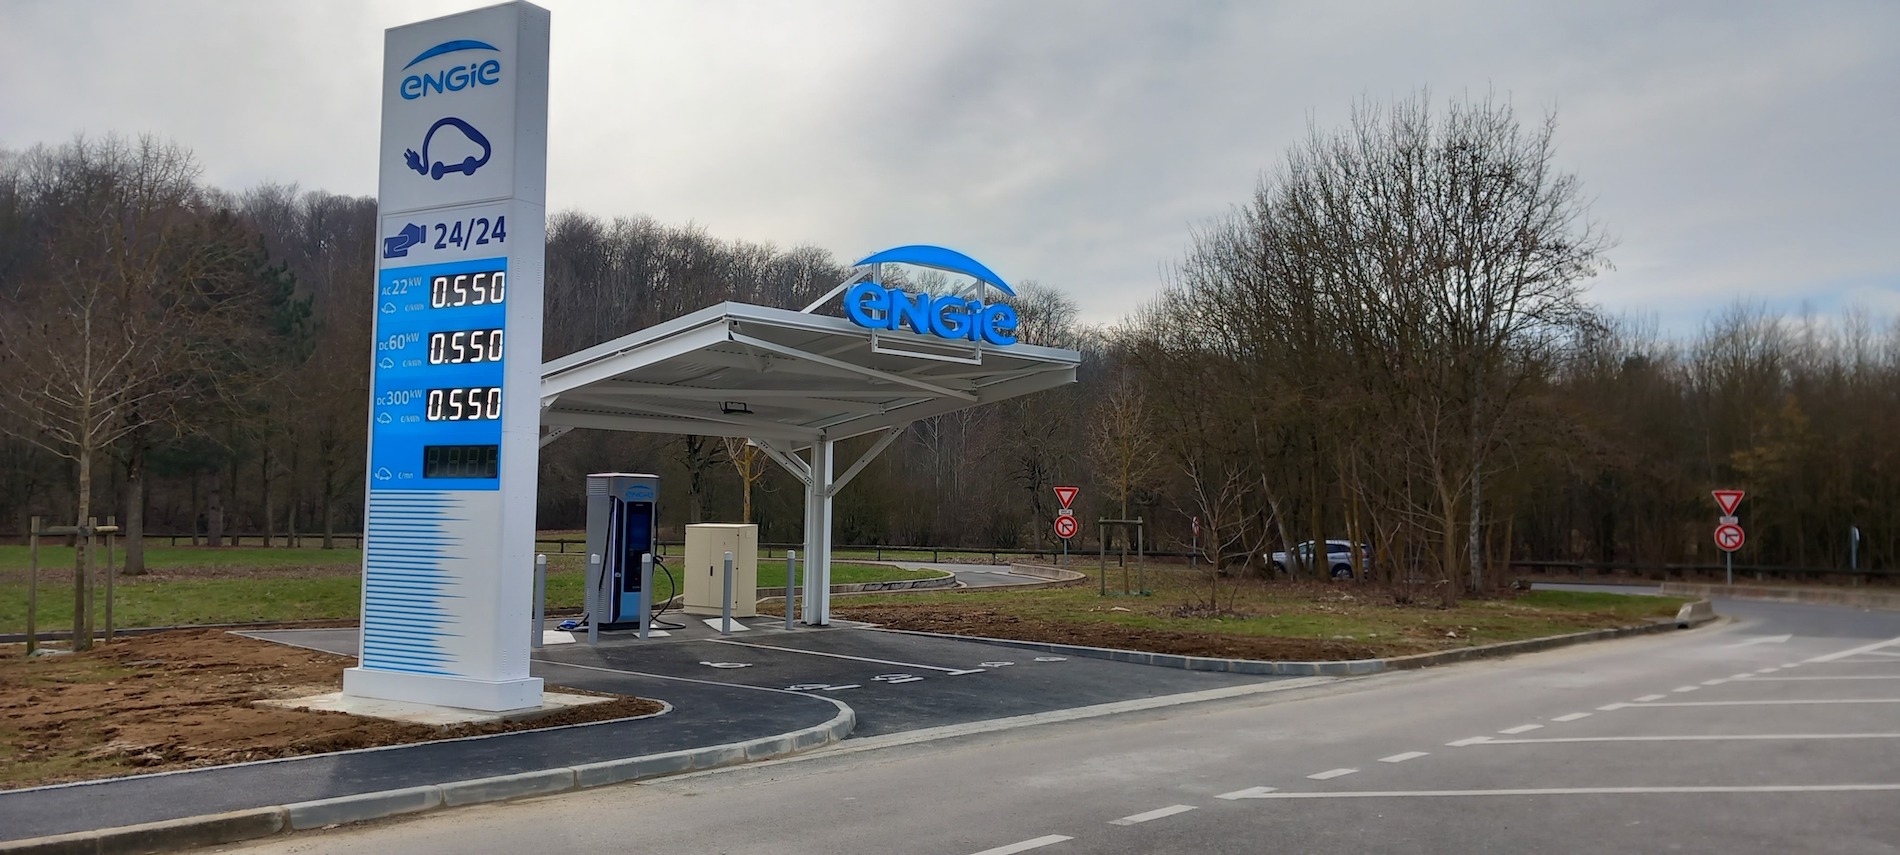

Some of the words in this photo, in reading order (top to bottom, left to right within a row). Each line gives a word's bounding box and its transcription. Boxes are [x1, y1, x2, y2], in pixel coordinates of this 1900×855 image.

[434, 216, 506, 251] 24/24
[432, 271, 505, 308] 0.550
[430, 329, 503, 365] 0.550
[427, 387, 501, 421] 0.550
